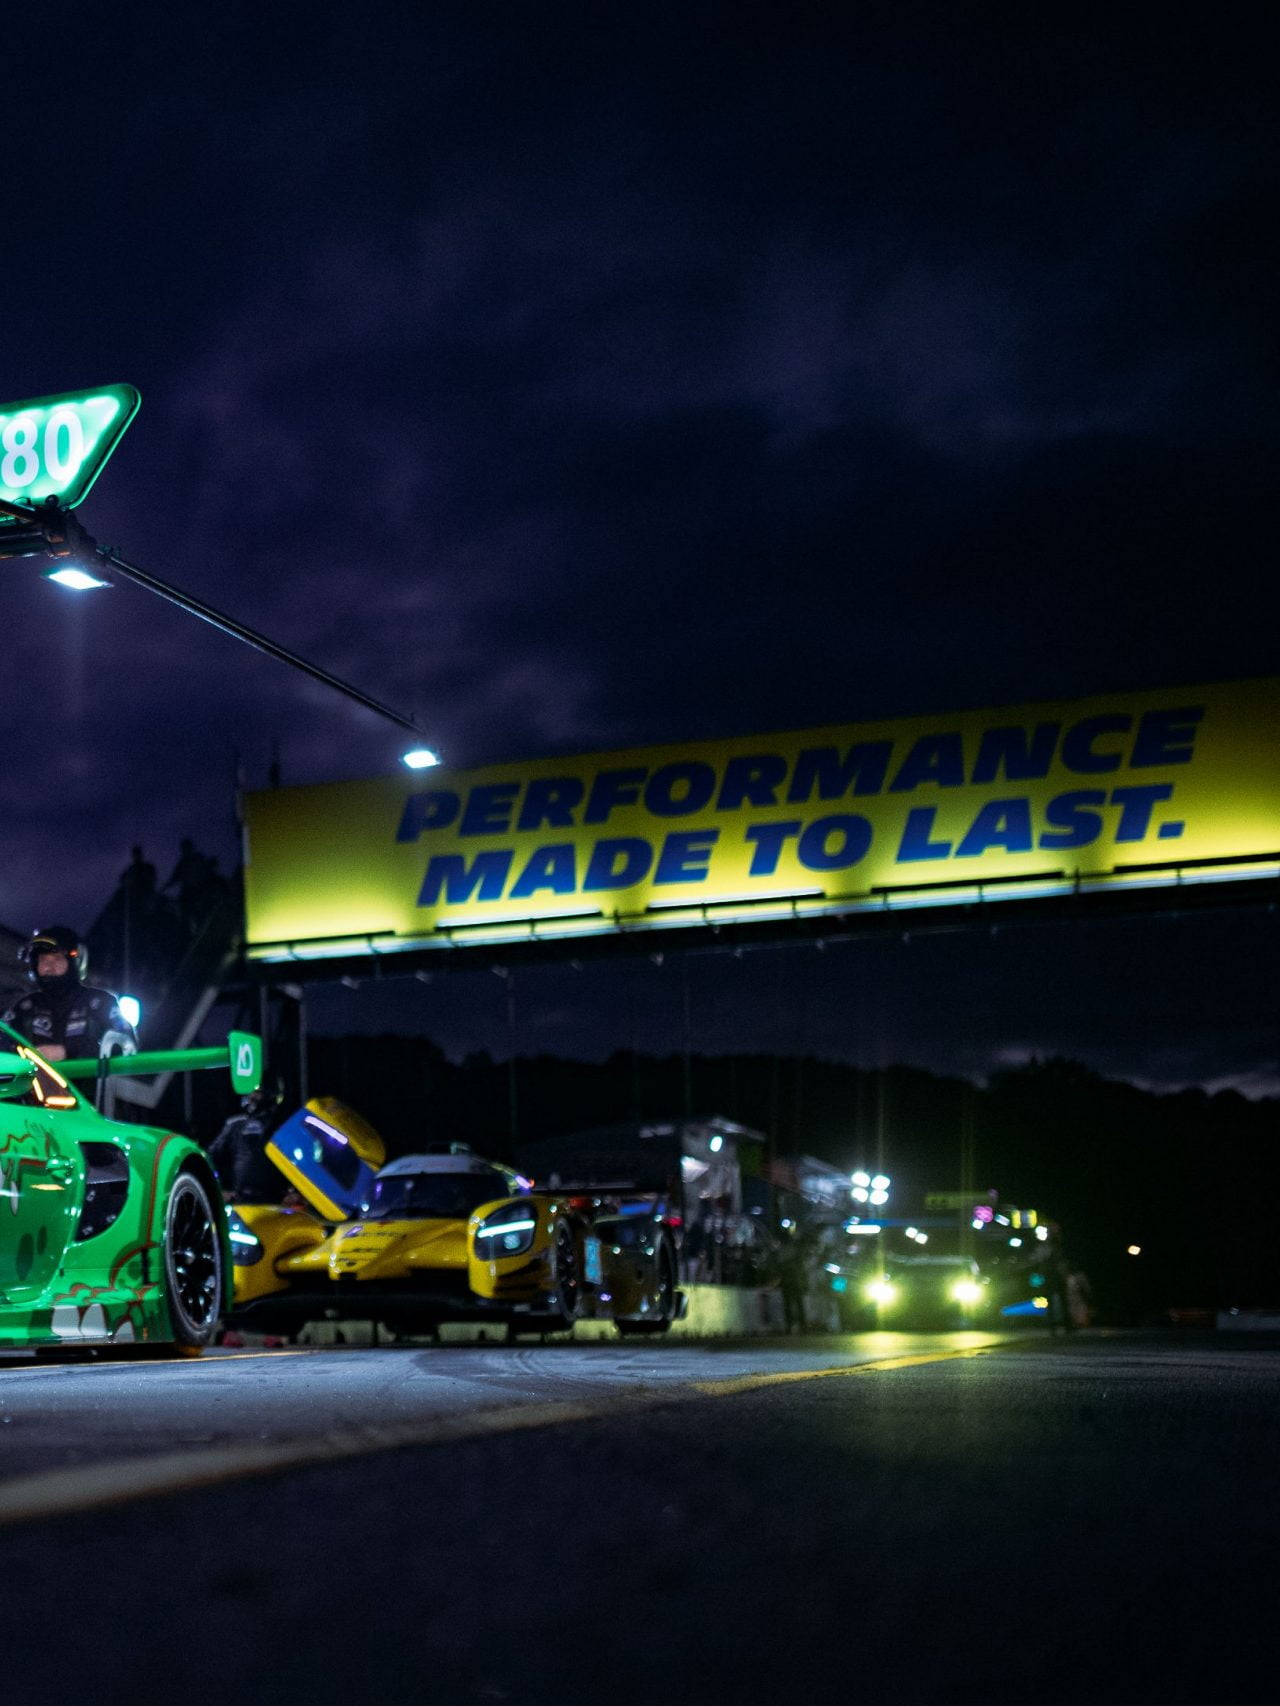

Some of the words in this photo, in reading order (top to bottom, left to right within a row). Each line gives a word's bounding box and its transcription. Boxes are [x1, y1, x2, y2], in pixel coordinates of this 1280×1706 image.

[1, 410, 84, 488] 80
[396, 706, 1205, 843] PERFORMANCE
[416, 829, 719, 908] MADE
[744, 812, 874, 878] TO
[895, 783, 1185, 864] LAST.
